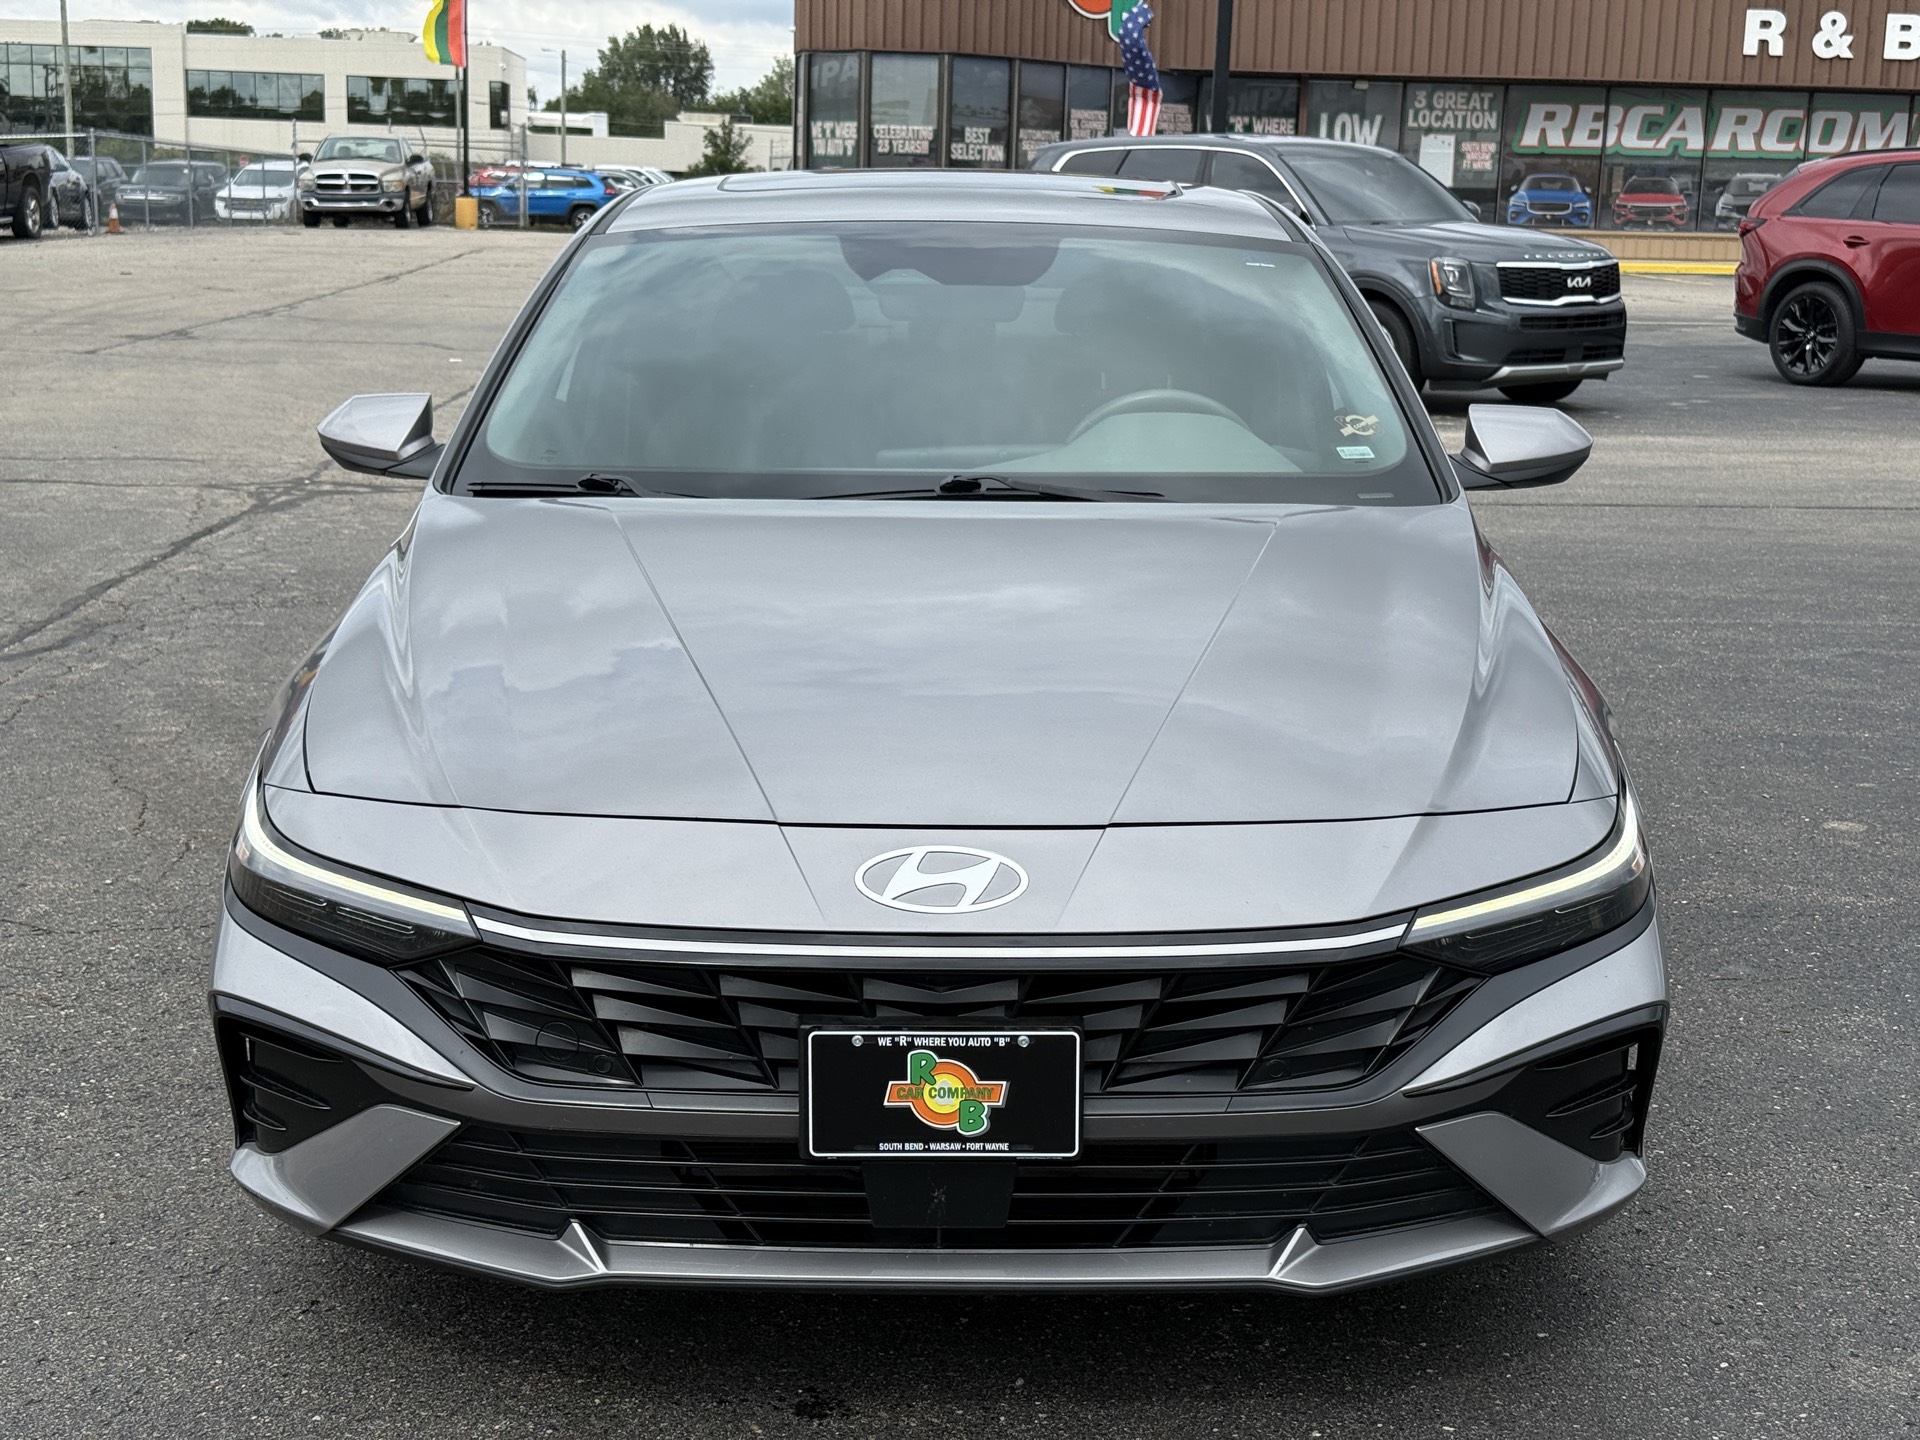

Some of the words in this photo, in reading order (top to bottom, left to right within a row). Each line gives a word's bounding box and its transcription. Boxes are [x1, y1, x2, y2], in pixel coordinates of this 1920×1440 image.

[1742, 9, 1787, 57] R
[1811, 10, 1855, 60] &
[1883, 13, 1920, 61] B
[1414, 91, 1427, 109] 3
[1432, 91, 1494, 110] GREAT
[1252, 116, 1296, 135] WHERE
[1407, 109, 1498, 129] LOCATION
[1519, 103, 1920, 153] RBCARCOM
[873, 124, 934, 140] CELEBRATING
[965, 127, 991, 144] BEST
[1319, 112, 1382, 146] LOW
[951, 144, 1004, 162] SELECTION
[1567, 276, 1592, 289] KIA
[877, 1037, 893, 1047] WE
[894, 1036, 912, 1047] "R"
[913, 1037, 947, 1047] WHERE
[947, 1037, 967, 1047] YOU
[967, 1037, 992, 1047] AUTO
[993, 1037, 1011, 1047] "B"
[910, 1052, 937, 1086] R
[896, 1086, 924, 1099] CAR
[928, 1086, 994, 1099] COMPANY
[958, 1099, 986, 1132] B
[879, 1142, 903, 1151] SOUTH
[904, 1142, 924, 1151] BEND
[929, 1142, 962, 1151] WARSAW
[966, 1142, 985, 1151] FORT
[985, 1142, 1010, 1151] WAYNE
